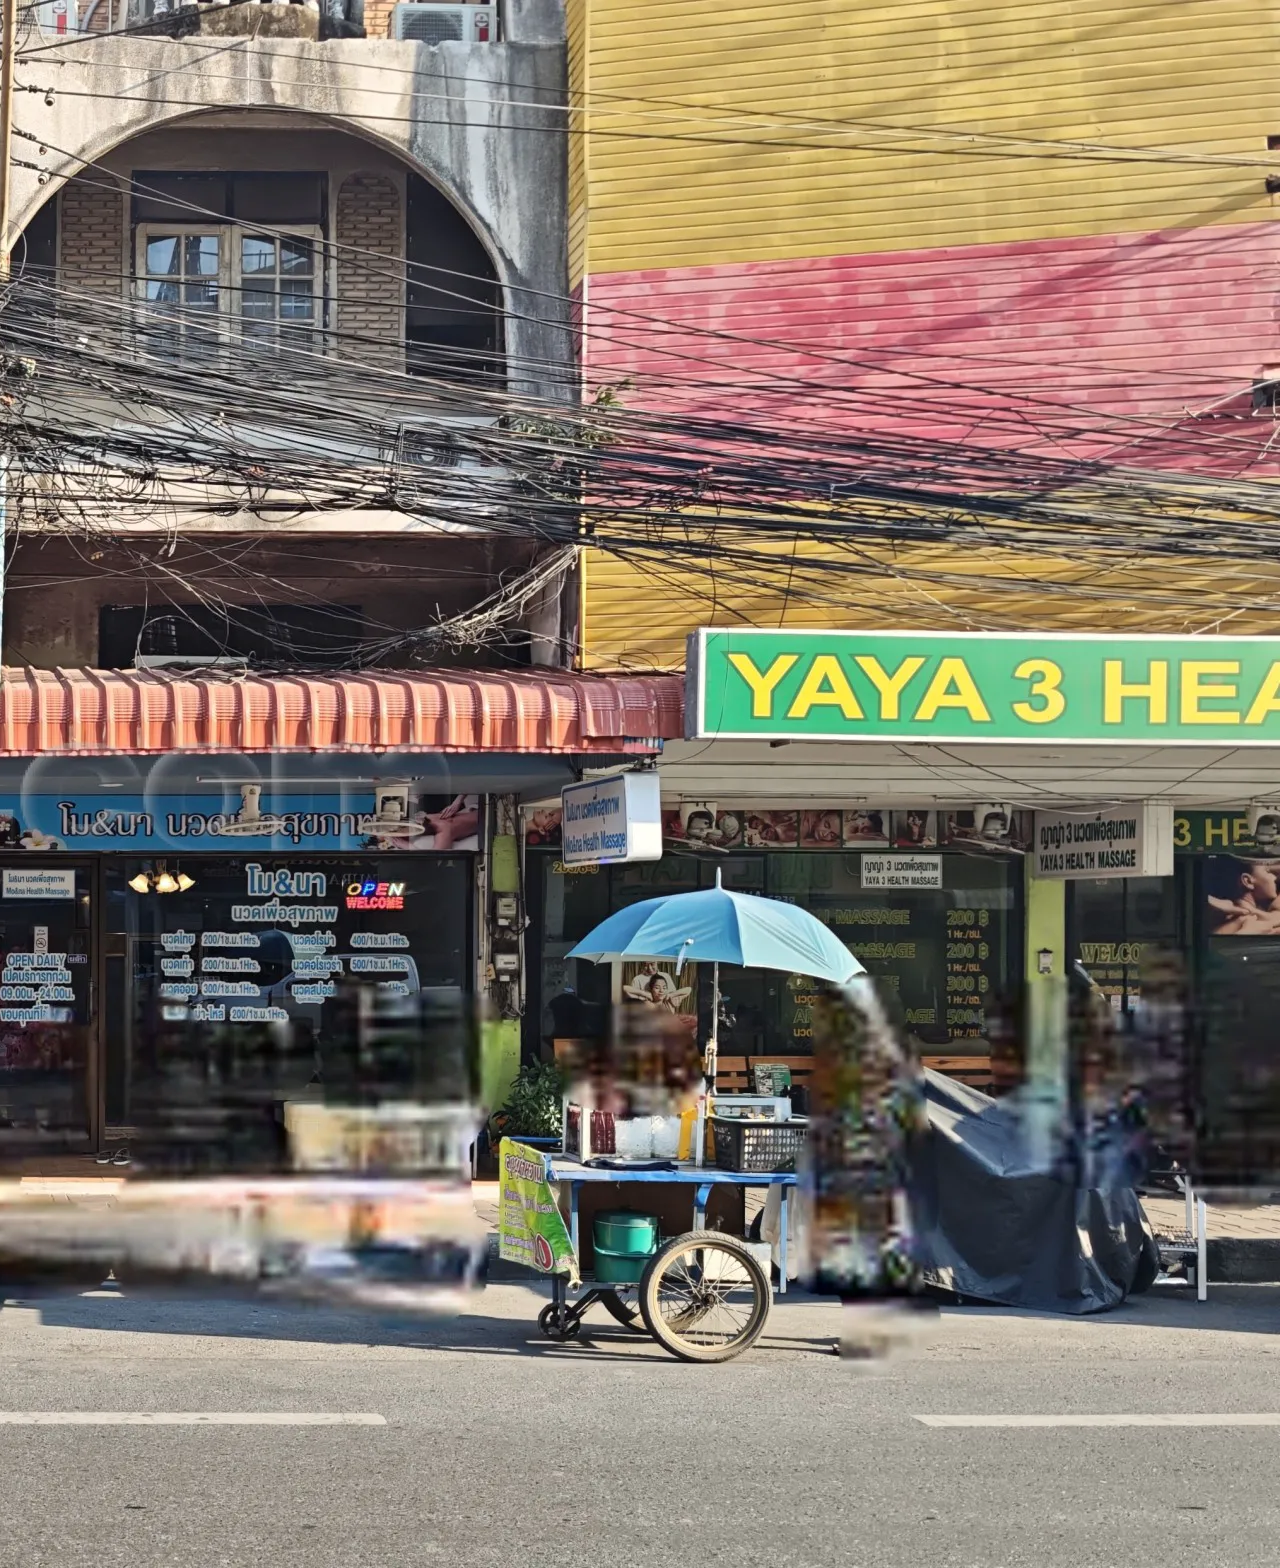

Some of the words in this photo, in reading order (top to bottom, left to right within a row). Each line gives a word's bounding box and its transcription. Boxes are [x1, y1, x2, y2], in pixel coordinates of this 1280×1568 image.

[728, 653, 991, 721] YAYA
[1012, 658, 1066, 724] 3
[58, 802, 154, 837] โม&นา
[1066, 822, 1073, 844] 3
[1173, 818, 1191, 847] 3
[601, 829, 626, 854] Massage
[886, 861, 892, 871] 3
[1040, 853, 1058, 871] YAYA
[1059, 854, 1064, 870] 3
[1065, 852, 1095, 870] HEALTH
[1098, 849, 1137, 869] MASSAGE
[246, 863, 326, 897] โม&นา
[865, 876, 880, 885] YAYA
[881, 876, 886, 885] 3
[887, 876, 909, 885] HEALTH
[911, 876, 939, 886] MASSAGE
[26, 887, 45, 895] Health
[45, 887, 70, 896] Massage
[346, 881, 405, 897] OPEN
[346, 896, 405, 910] WELCOME
[231, 900, 339, 927] นวดเพื่อสุขภาพ
[836, 909, 911, 925] MASSAGE
[946, 910, 975, 926] 200
[161, 929, 195, 946] นวดไทย
[946, 943, 975, 958] 200
[1080, 943, 1140, 964] WELCO
[7, 953, 36, 967] OPEN
[36, 953, 67, 967] DAILY
[161, 955, 195, 971] นวดเท้า
[2, 968, 72, 988] เปิดบริการทุกวัน
[946, 976, 975, 991] 300
[292, 980, 338, 997] นวดสปอร์
[946, 1008, 975, 1024] 500
